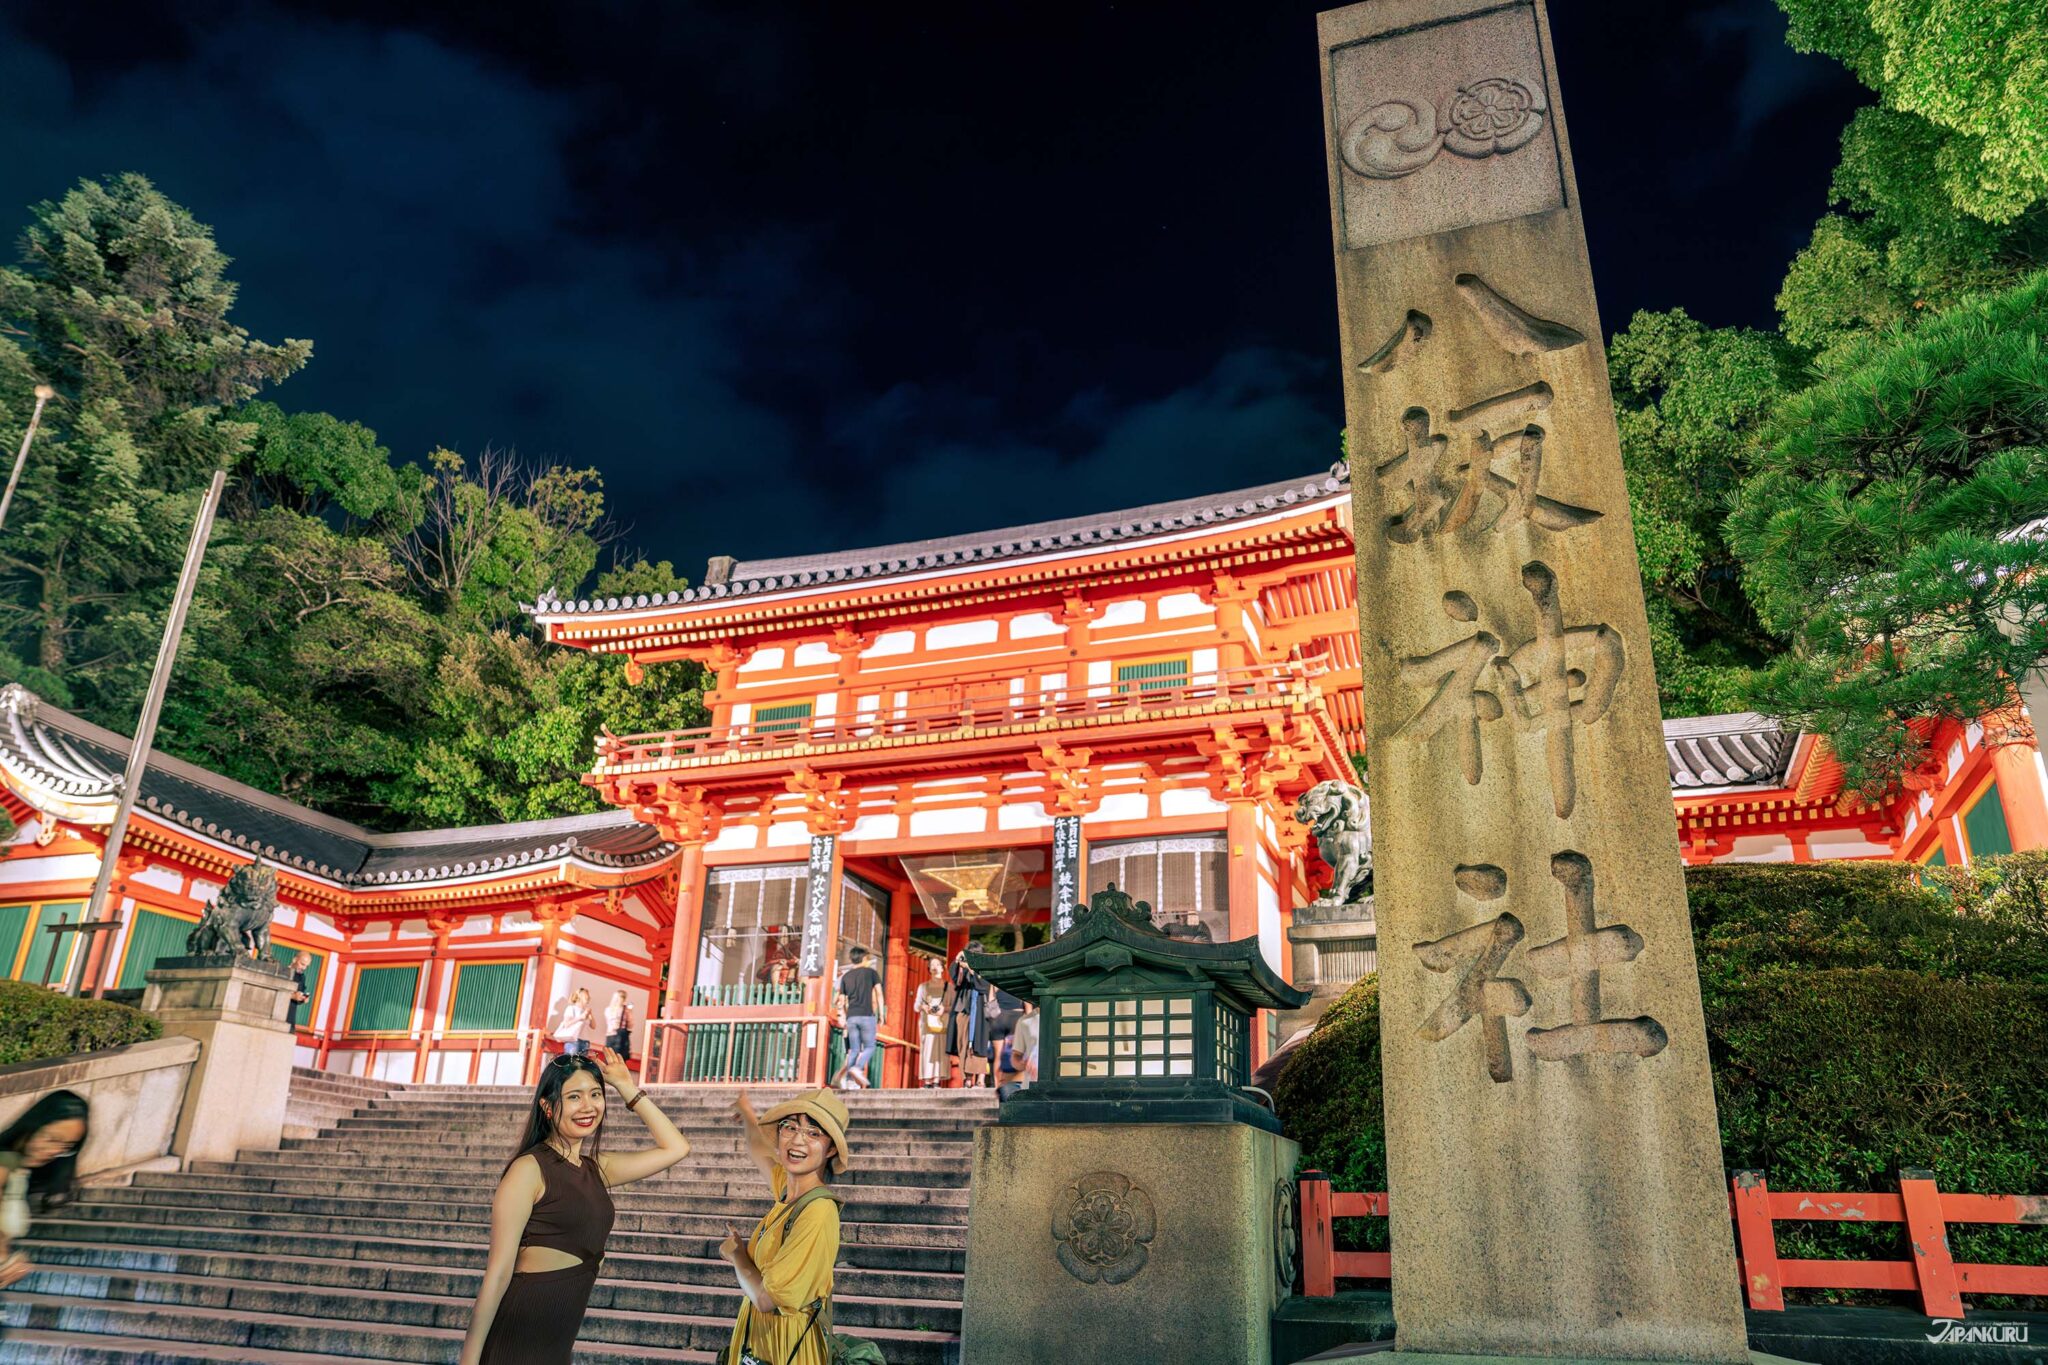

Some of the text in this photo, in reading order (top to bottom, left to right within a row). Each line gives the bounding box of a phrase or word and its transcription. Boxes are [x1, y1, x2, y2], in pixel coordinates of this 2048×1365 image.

[1067, 817, 1078, 858] 七月七日
[1357, 272, 1667, 1083] 八坂神社
